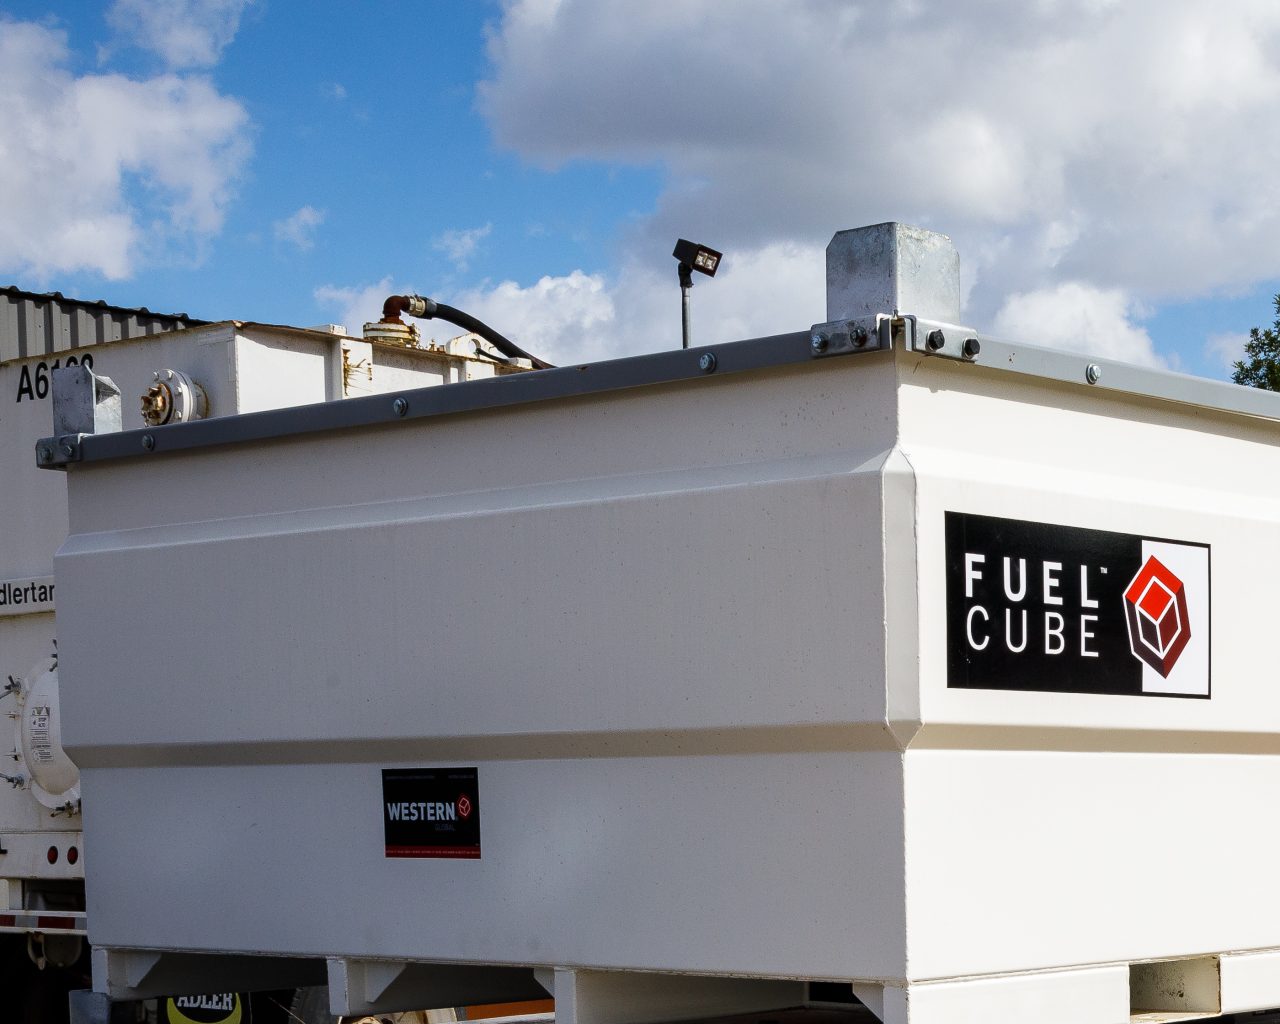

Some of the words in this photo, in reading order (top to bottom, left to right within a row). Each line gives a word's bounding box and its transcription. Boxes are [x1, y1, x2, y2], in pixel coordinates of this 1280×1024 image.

[965, 552, 1099, 609] FUEL
[966, 605, 1099, 658] CUBE
[387, 802, 456, 821] WESTERN
